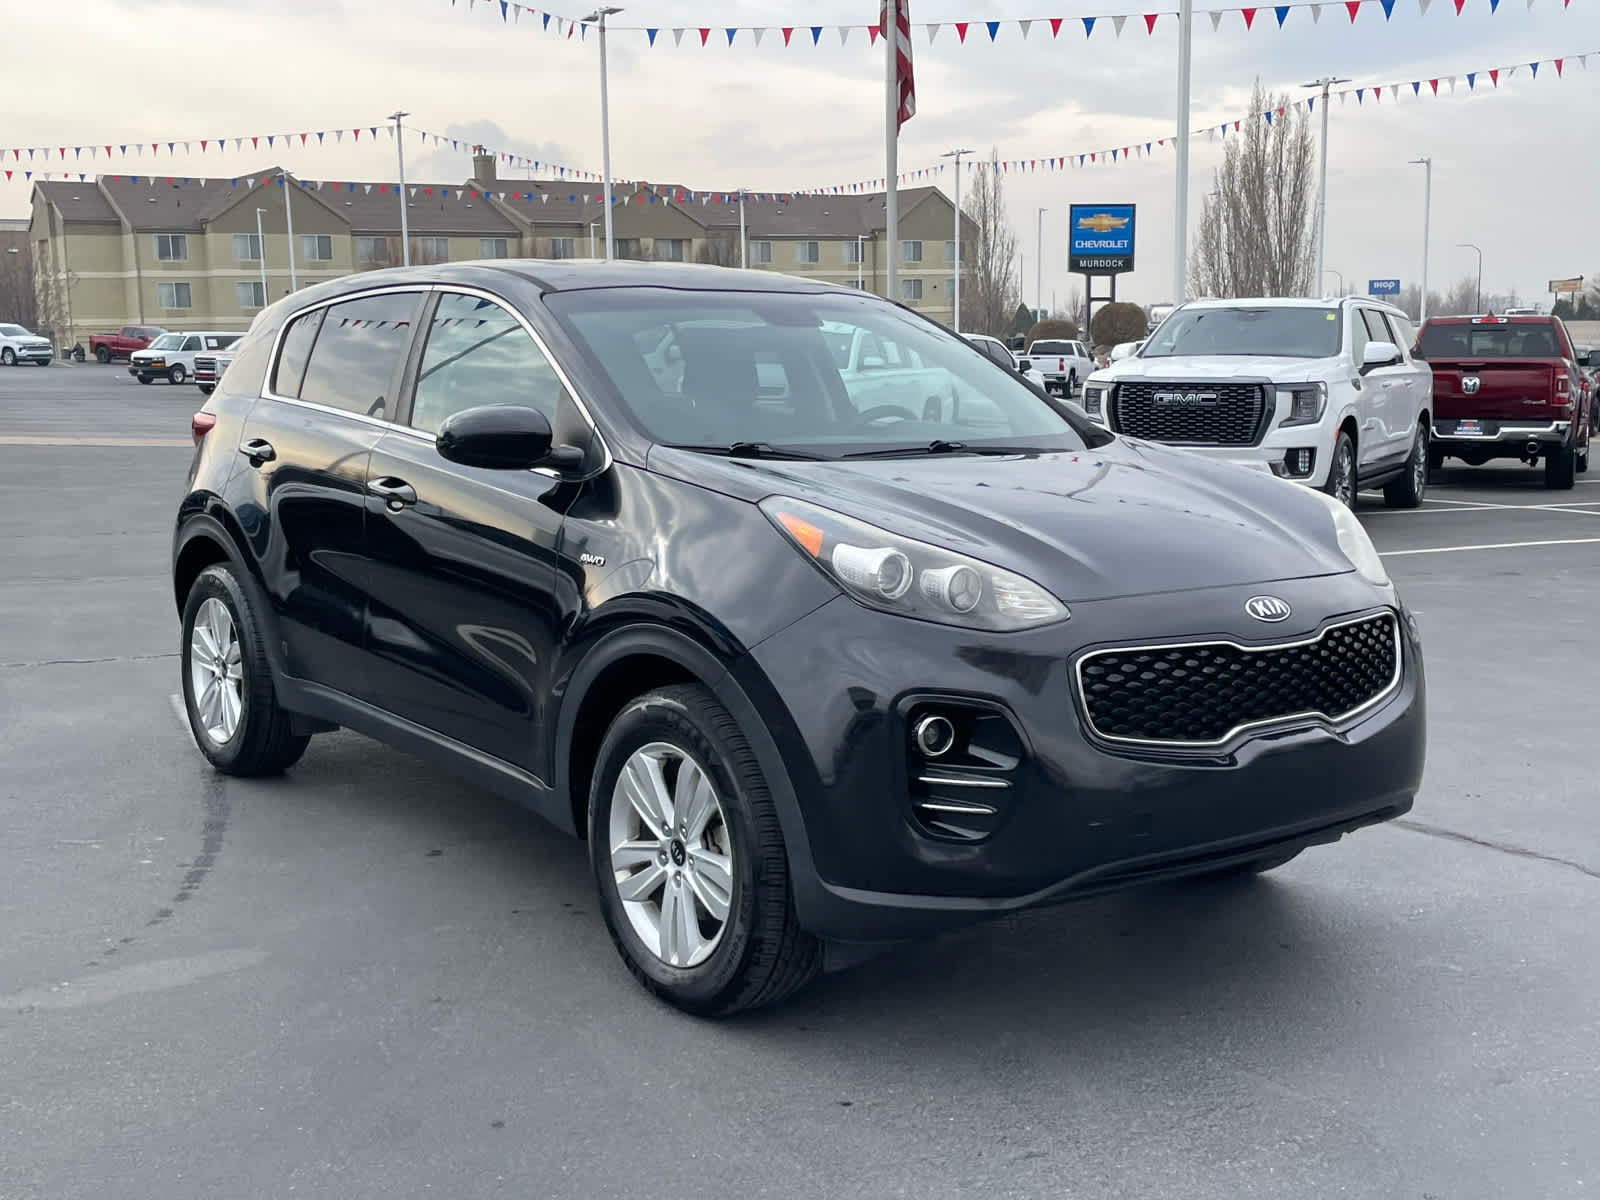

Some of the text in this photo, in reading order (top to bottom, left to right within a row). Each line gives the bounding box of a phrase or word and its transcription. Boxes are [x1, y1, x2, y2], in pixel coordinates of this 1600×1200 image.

[1075, 239, 1129, 248] CHEVROLET
[1079, 259, 1124, 268] MURDOCK
[1153, 393, 1217, 406] GMC
[580, 553, 605, 566] AWD
[1251, 599, 1288, 617] KIA
